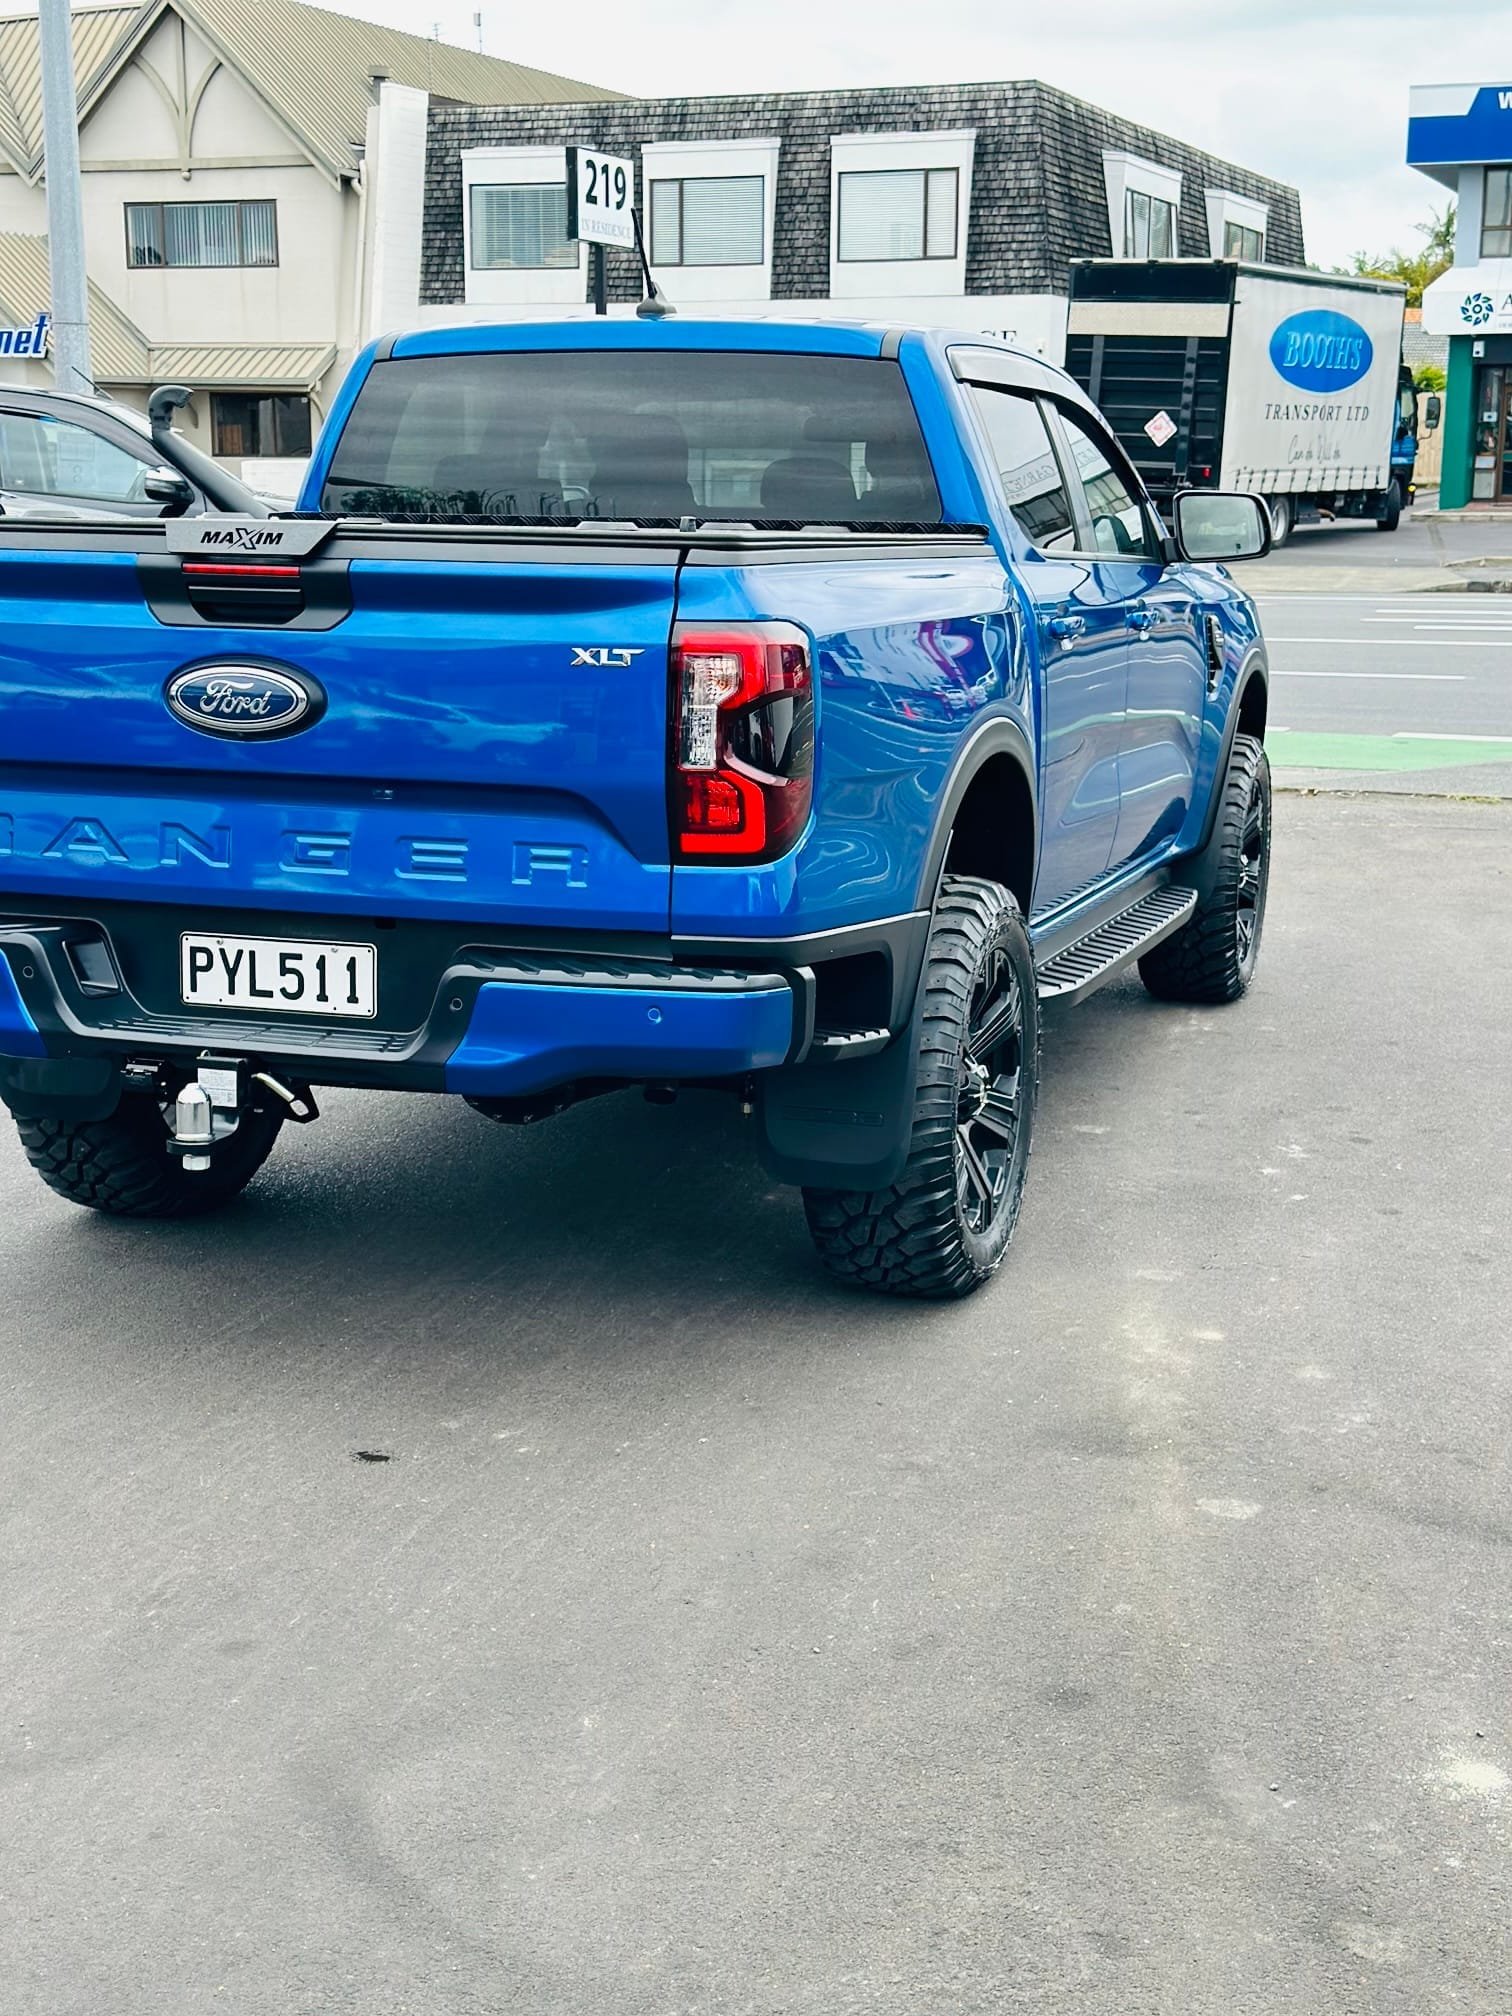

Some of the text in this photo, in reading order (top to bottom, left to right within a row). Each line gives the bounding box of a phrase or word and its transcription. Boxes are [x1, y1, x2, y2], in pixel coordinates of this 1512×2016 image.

[586, 159, 626, 210] 219
[1265, 403, 1369, 421] TRANSPORT LTD
[200, 527, 284, 550] MAXIM
[570, 647, 646, 667] XLT
[200, 679, 273, 715] Ford
[0, 812, 590, 888] ANGER
[190, 945, 359, 1004] PYL511
